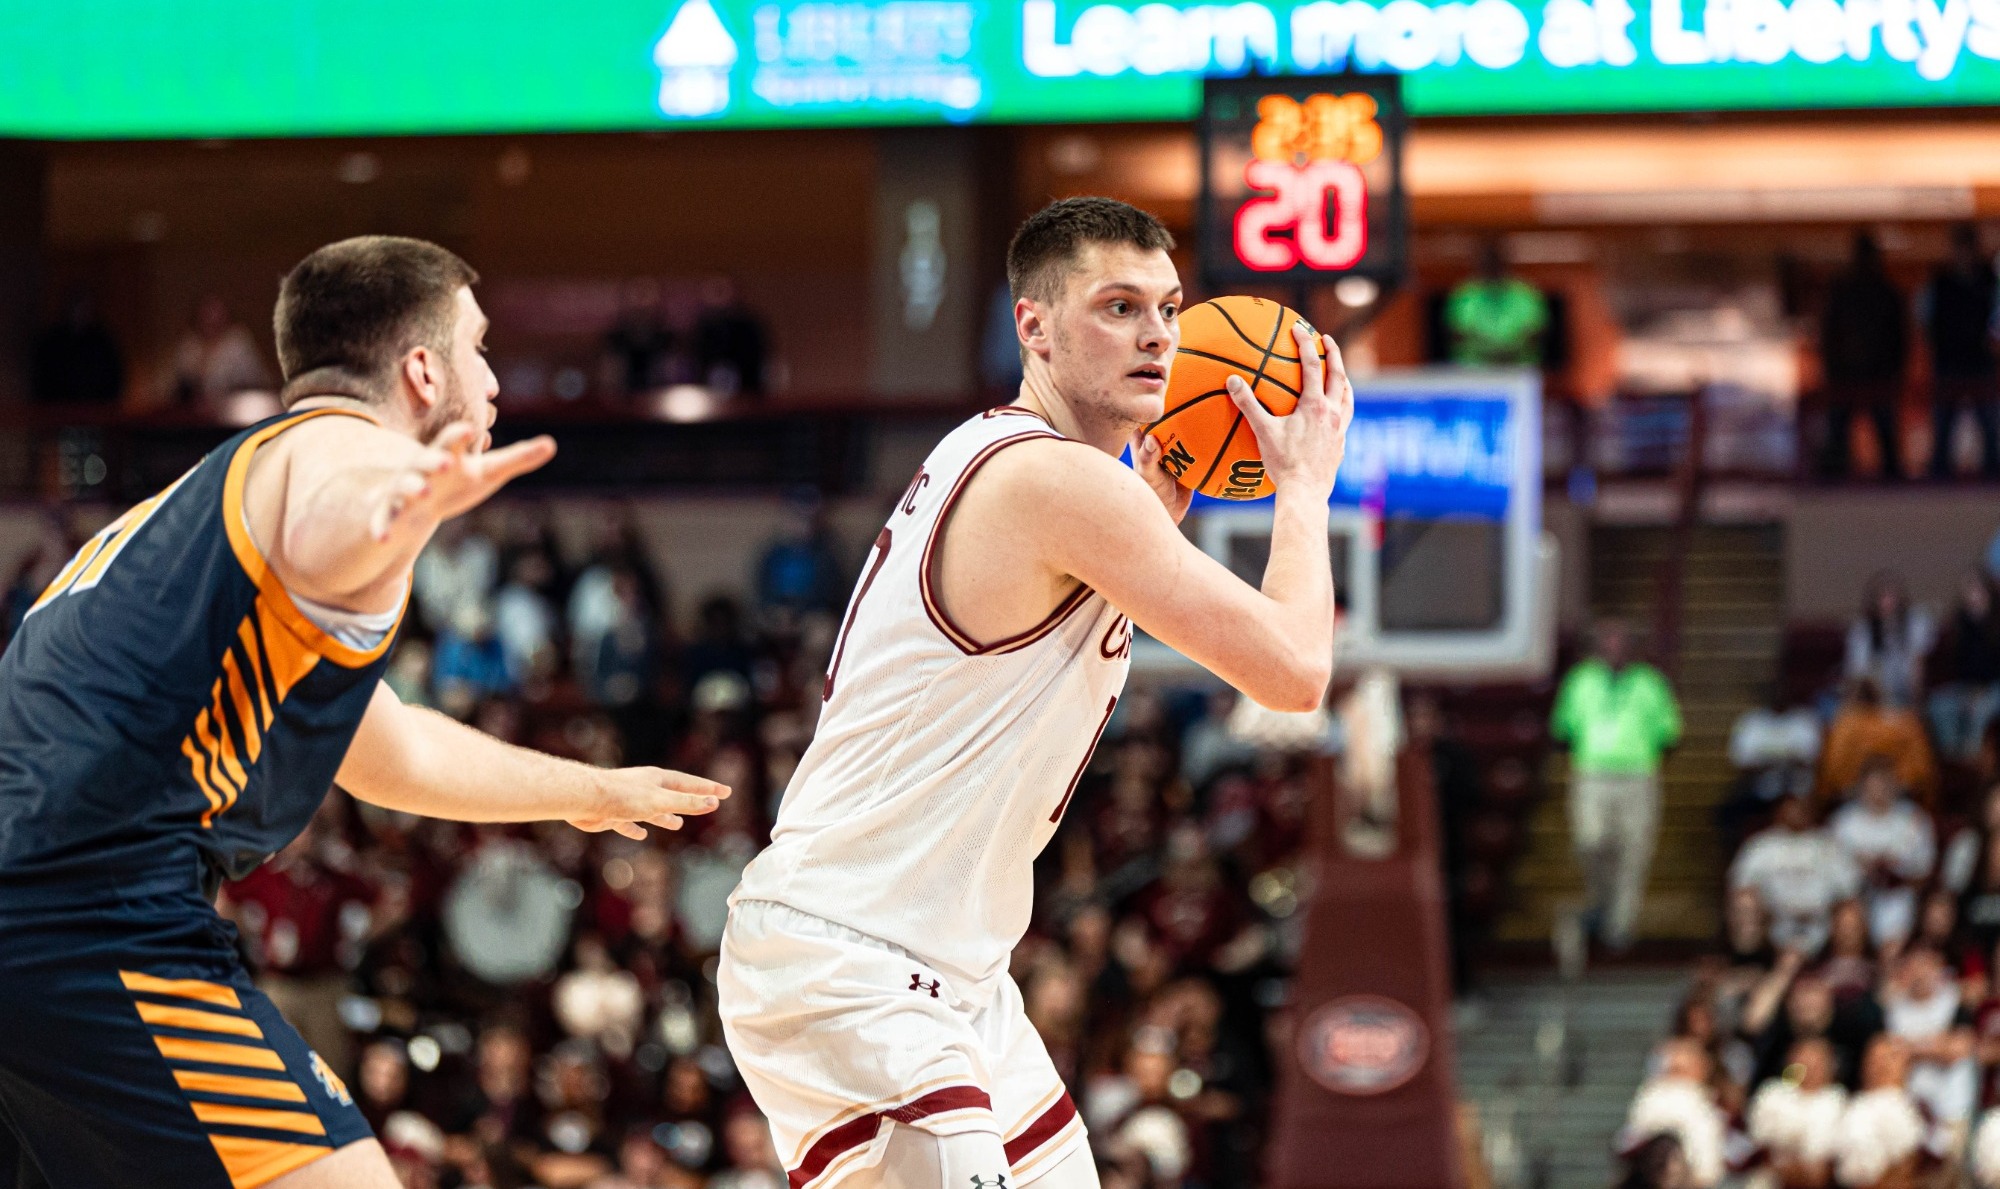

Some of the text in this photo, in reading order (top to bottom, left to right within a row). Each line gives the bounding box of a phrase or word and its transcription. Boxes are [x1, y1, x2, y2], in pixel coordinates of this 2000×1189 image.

[1023, 0, 1276, 77] Learn
[1290, 0, 1529, 70] more
[1538, 0, 1638, 67] at
[1233, 157, 1369, 272] 20
